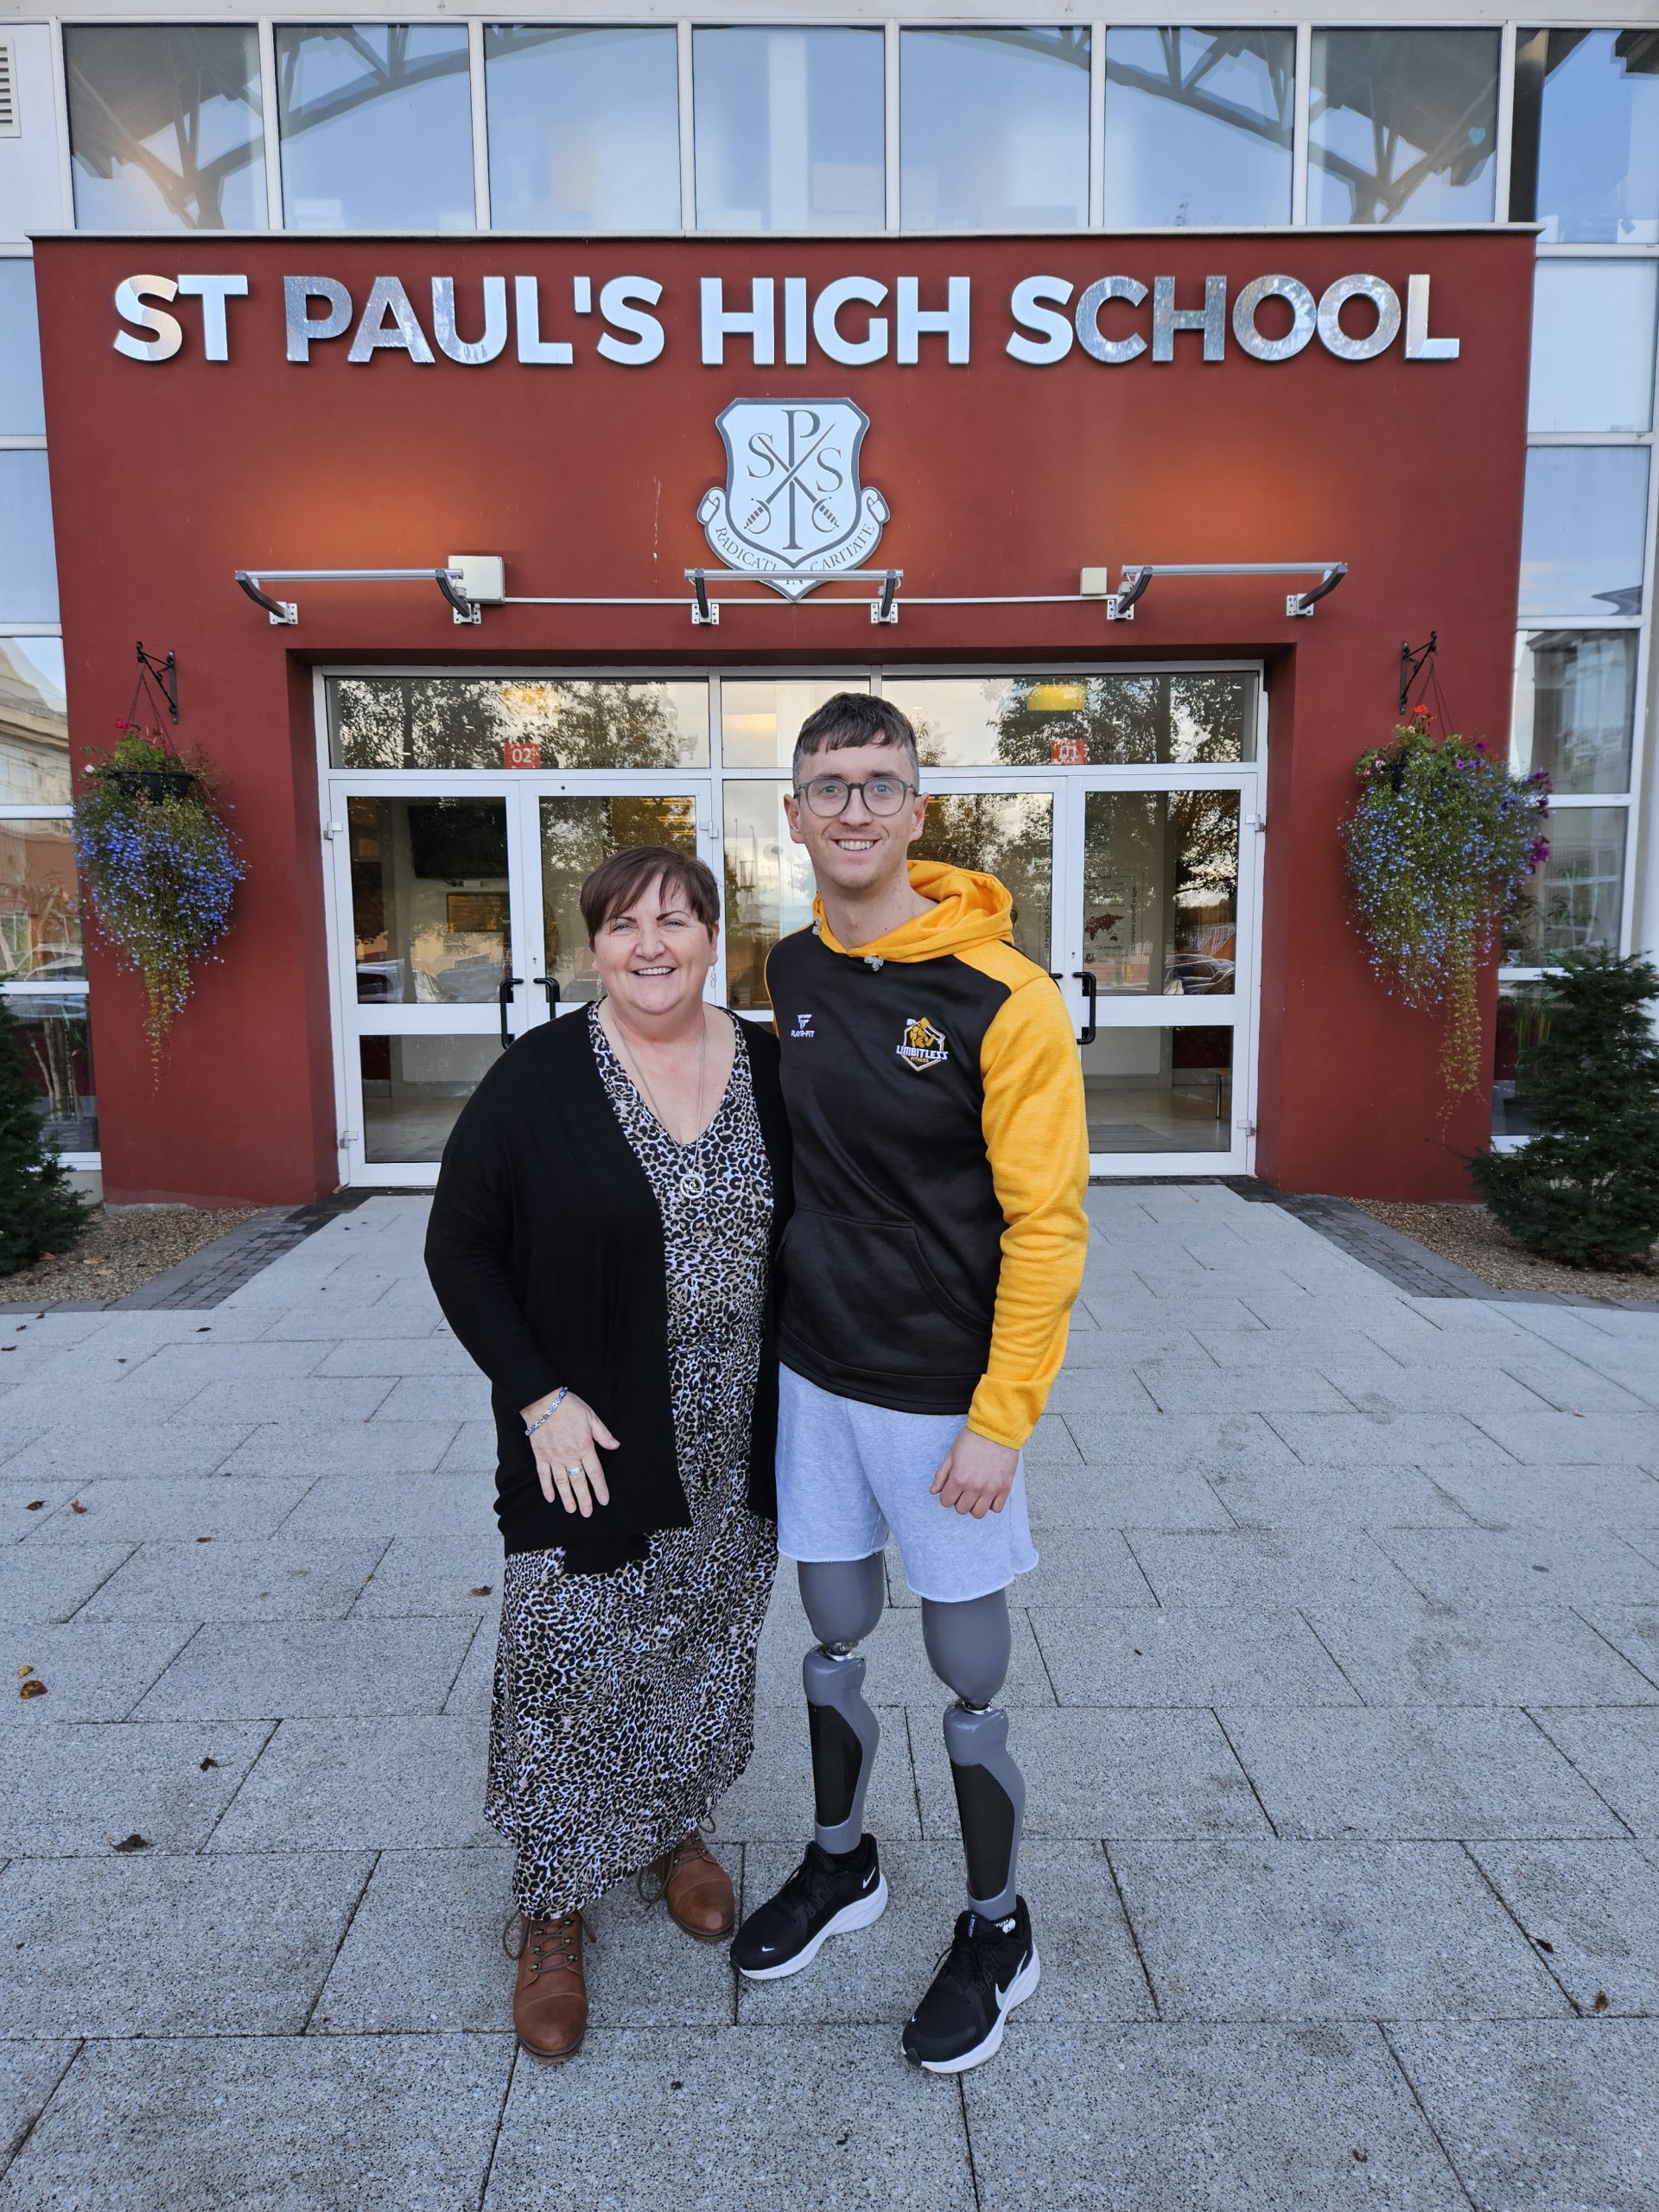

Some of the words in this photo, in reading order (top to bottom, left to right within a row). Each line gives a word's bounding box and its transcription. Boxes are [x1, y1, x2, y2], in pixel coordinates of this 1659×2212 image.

[113, 273, 249, 362] ST
[283, 275, 665, 365] PAUL'S
[700, 275, 971, 365] HIGH
[1006, 273, 1460, 365] SCHOOL
[512, 747, 532, 763] 02
[896, 1045, 949, 1060] LIMBITLESS
